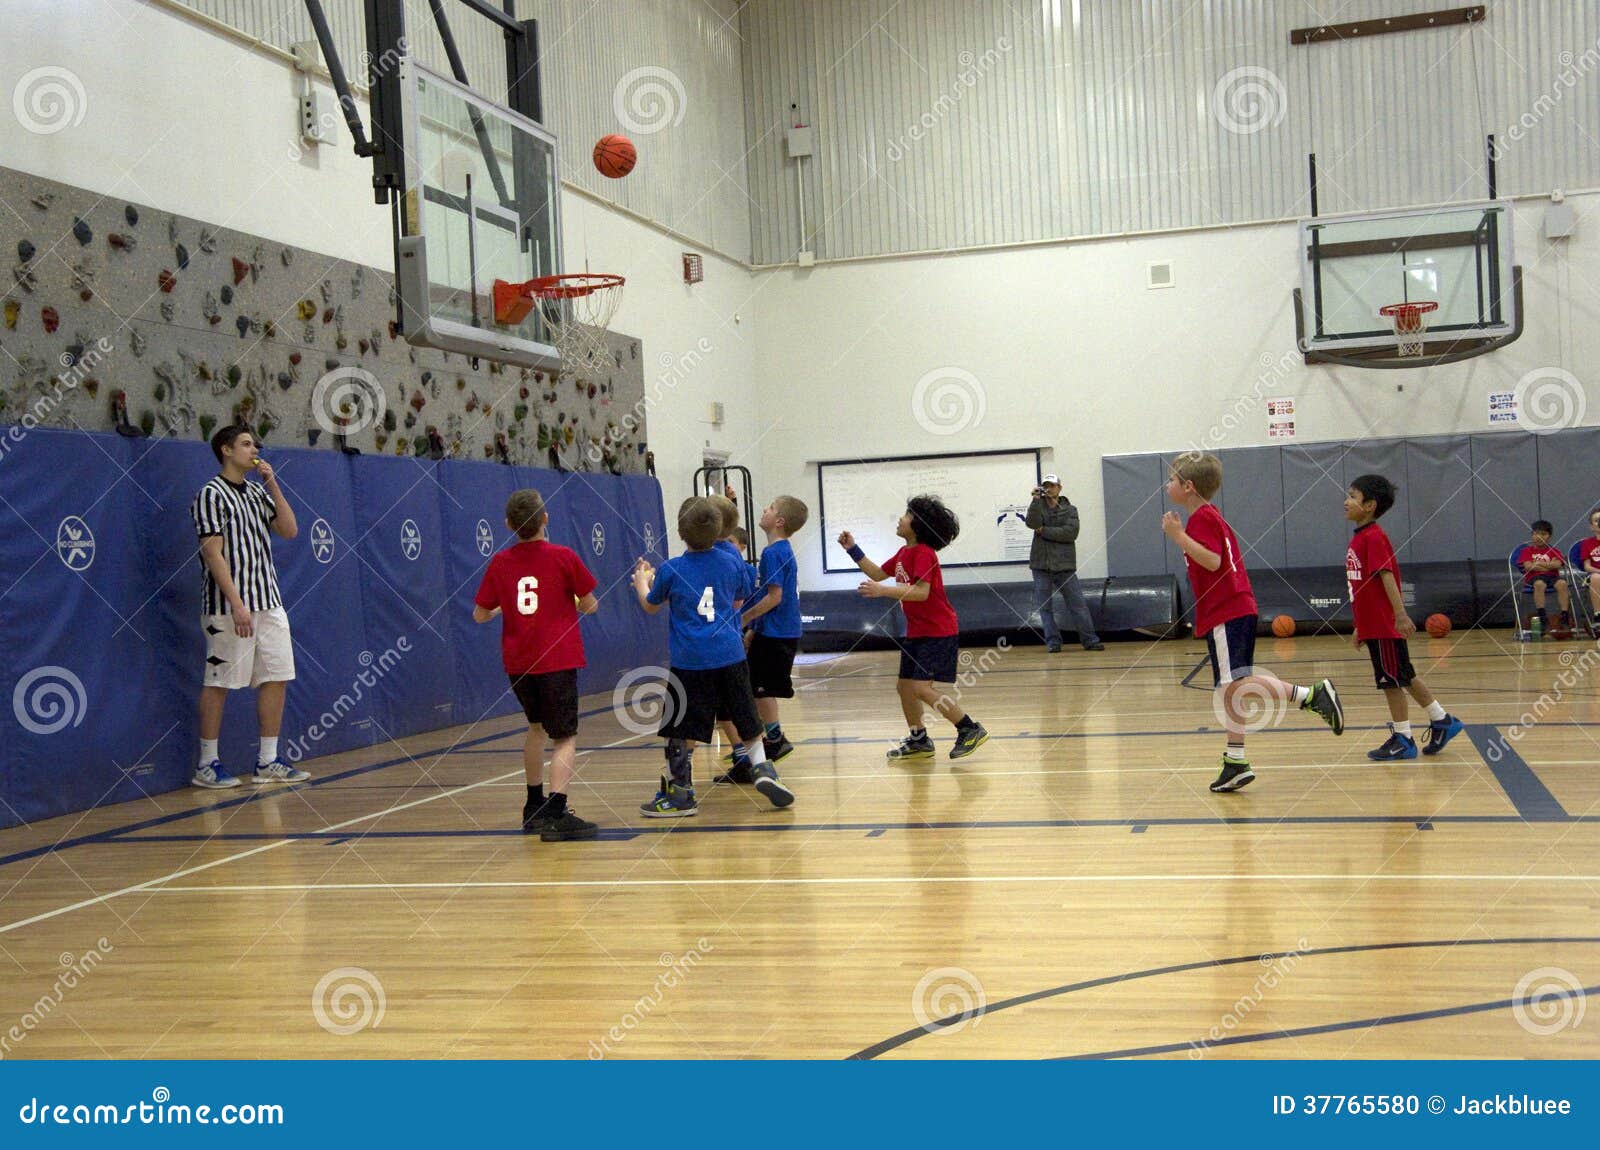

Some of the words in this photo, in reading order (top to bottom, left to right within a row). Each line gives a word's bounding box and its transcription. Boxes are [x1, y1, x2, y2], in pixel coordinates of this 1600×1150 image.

[1490, 413, 1517, 421] MATS
[517, 576, 539, 615] 6
[697, 586, 715, 622] 4
